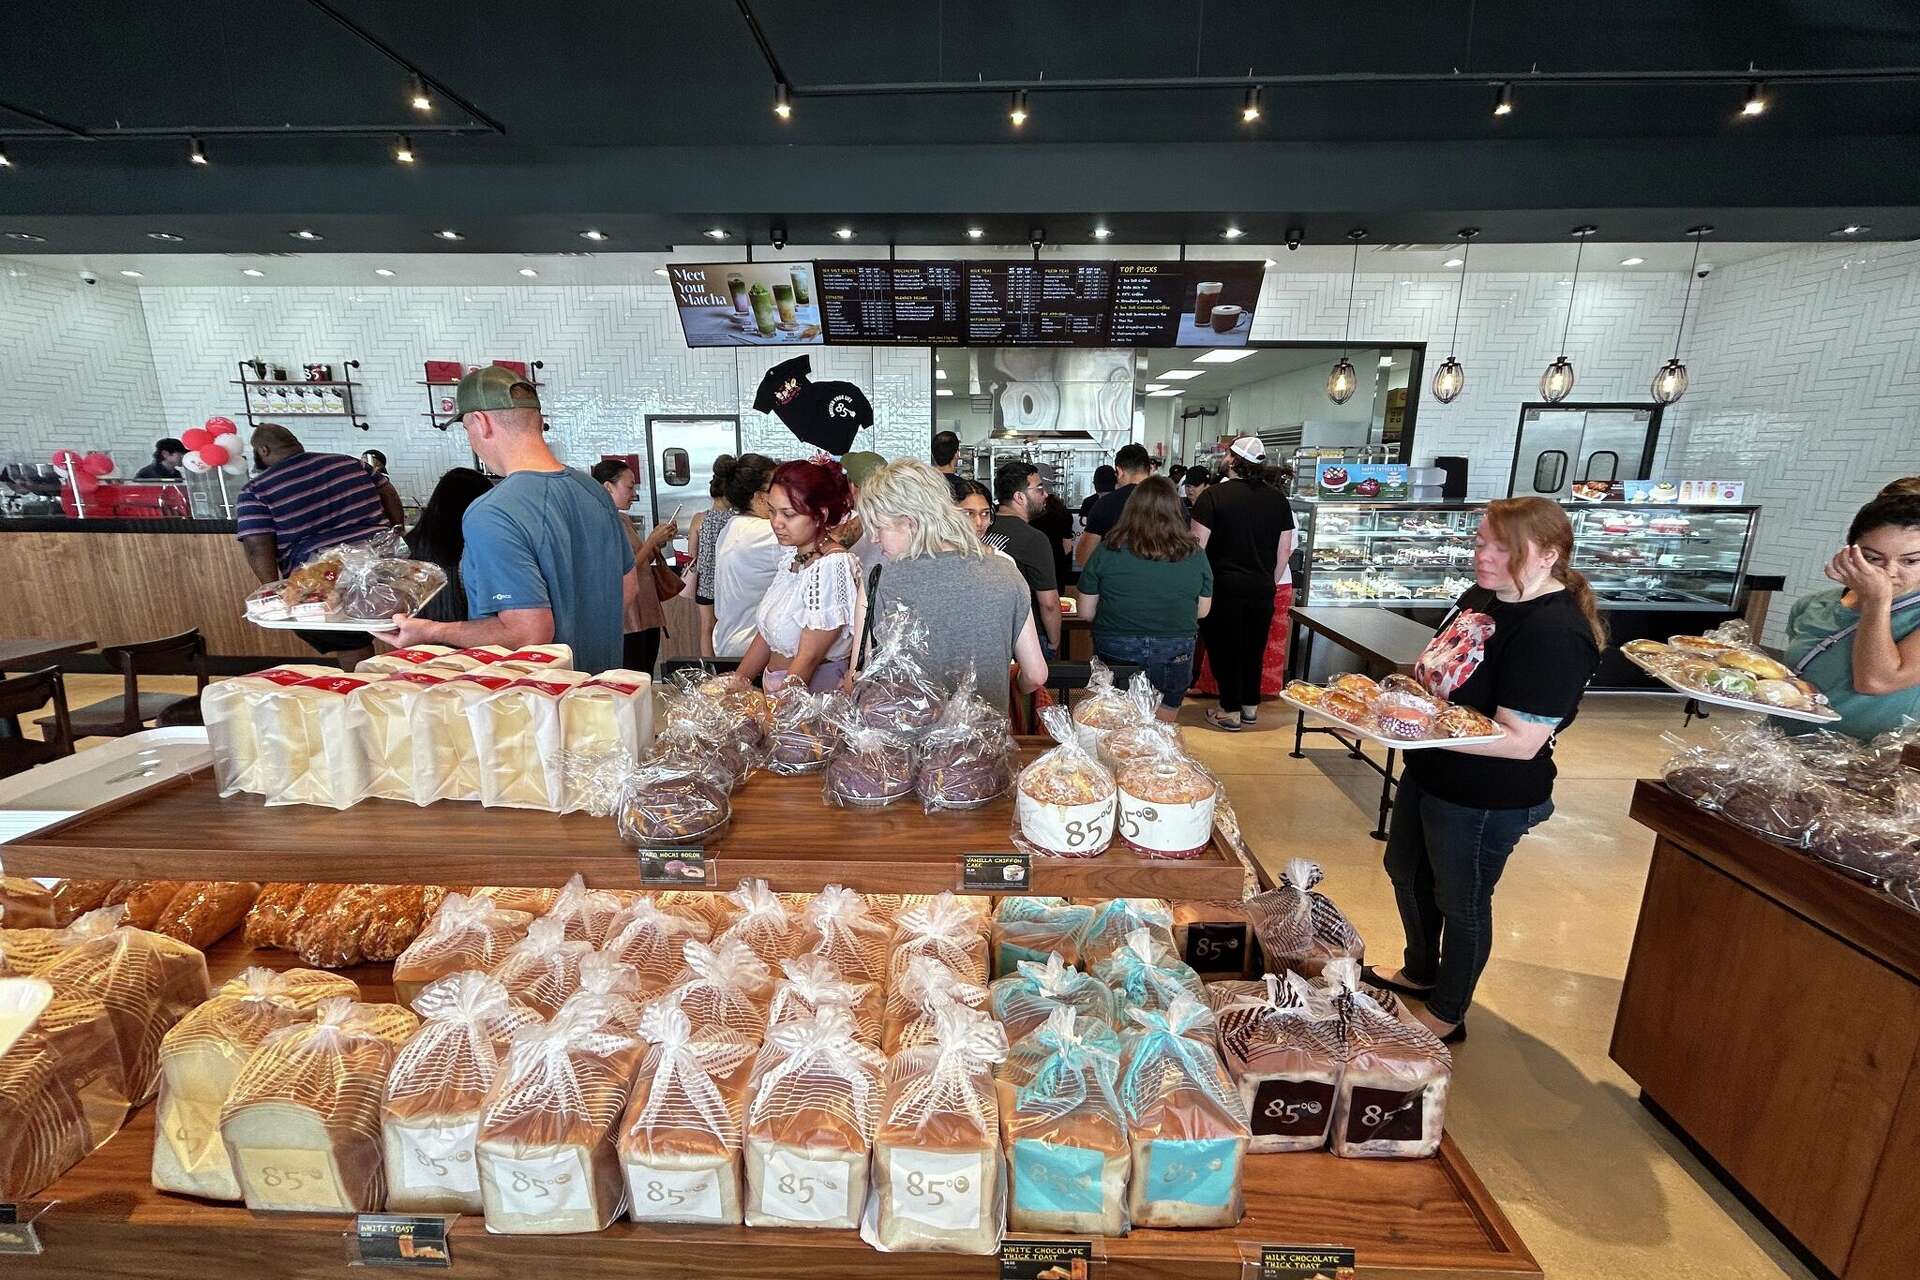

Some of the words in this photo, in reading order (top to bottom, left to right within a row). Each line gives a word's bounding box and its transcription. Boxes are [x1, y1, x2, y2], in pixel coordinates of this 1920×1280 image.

[674, 268, 706, 281] Meet
[676, 282, 704, 294] Your
[680, 294, 727, 306] Matcha
[1290, 1254, 1340, 1263] CHOCOLATE
